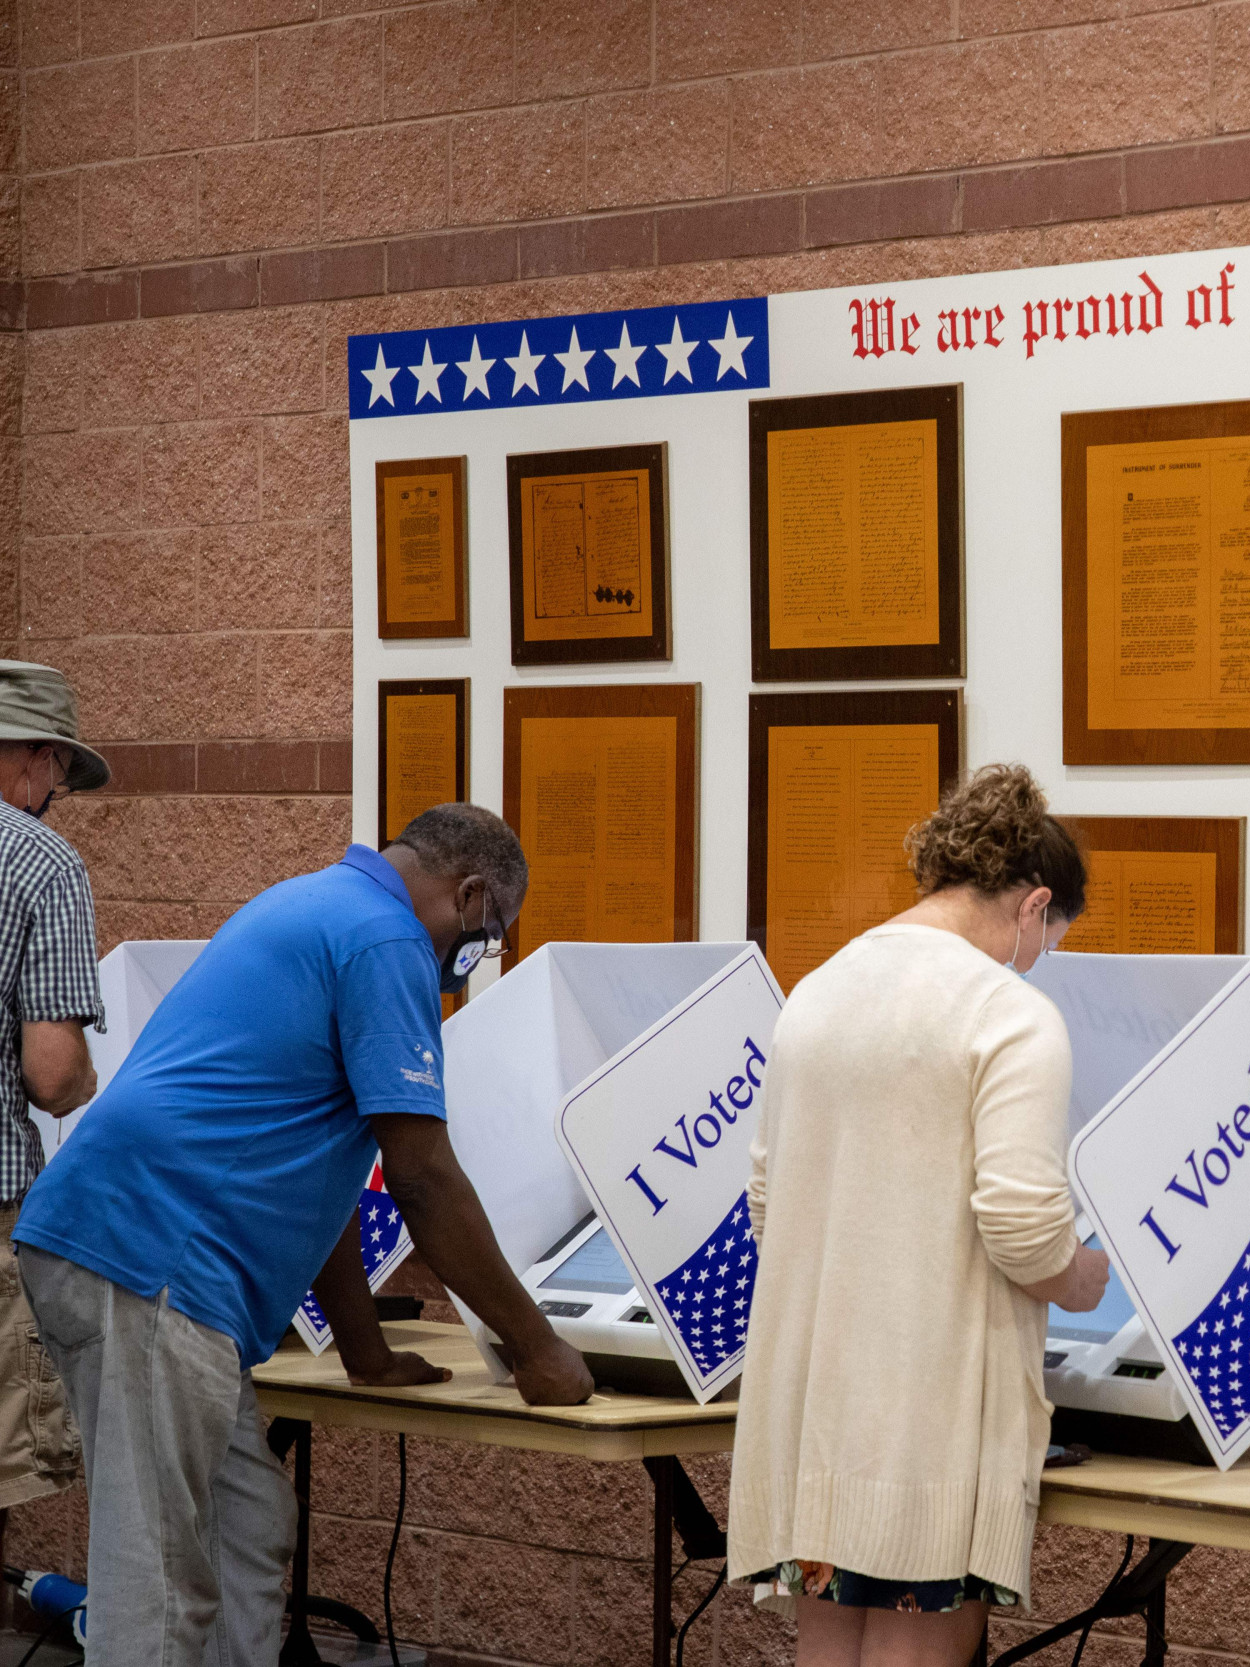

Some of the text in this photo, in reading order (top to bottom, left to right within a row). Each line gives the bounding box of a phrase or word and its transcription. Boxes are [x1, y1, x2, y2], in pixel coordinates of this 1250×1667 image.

[848, 296, 921, 359] We
[936, 303, 1005, 353] are
[1021, 270, 1164, 359] proud
[1185, 262, 1237, 328] of
[624, 1036, 767, 1217] I Voted
[1139, 1206, 1182, 1265] I
